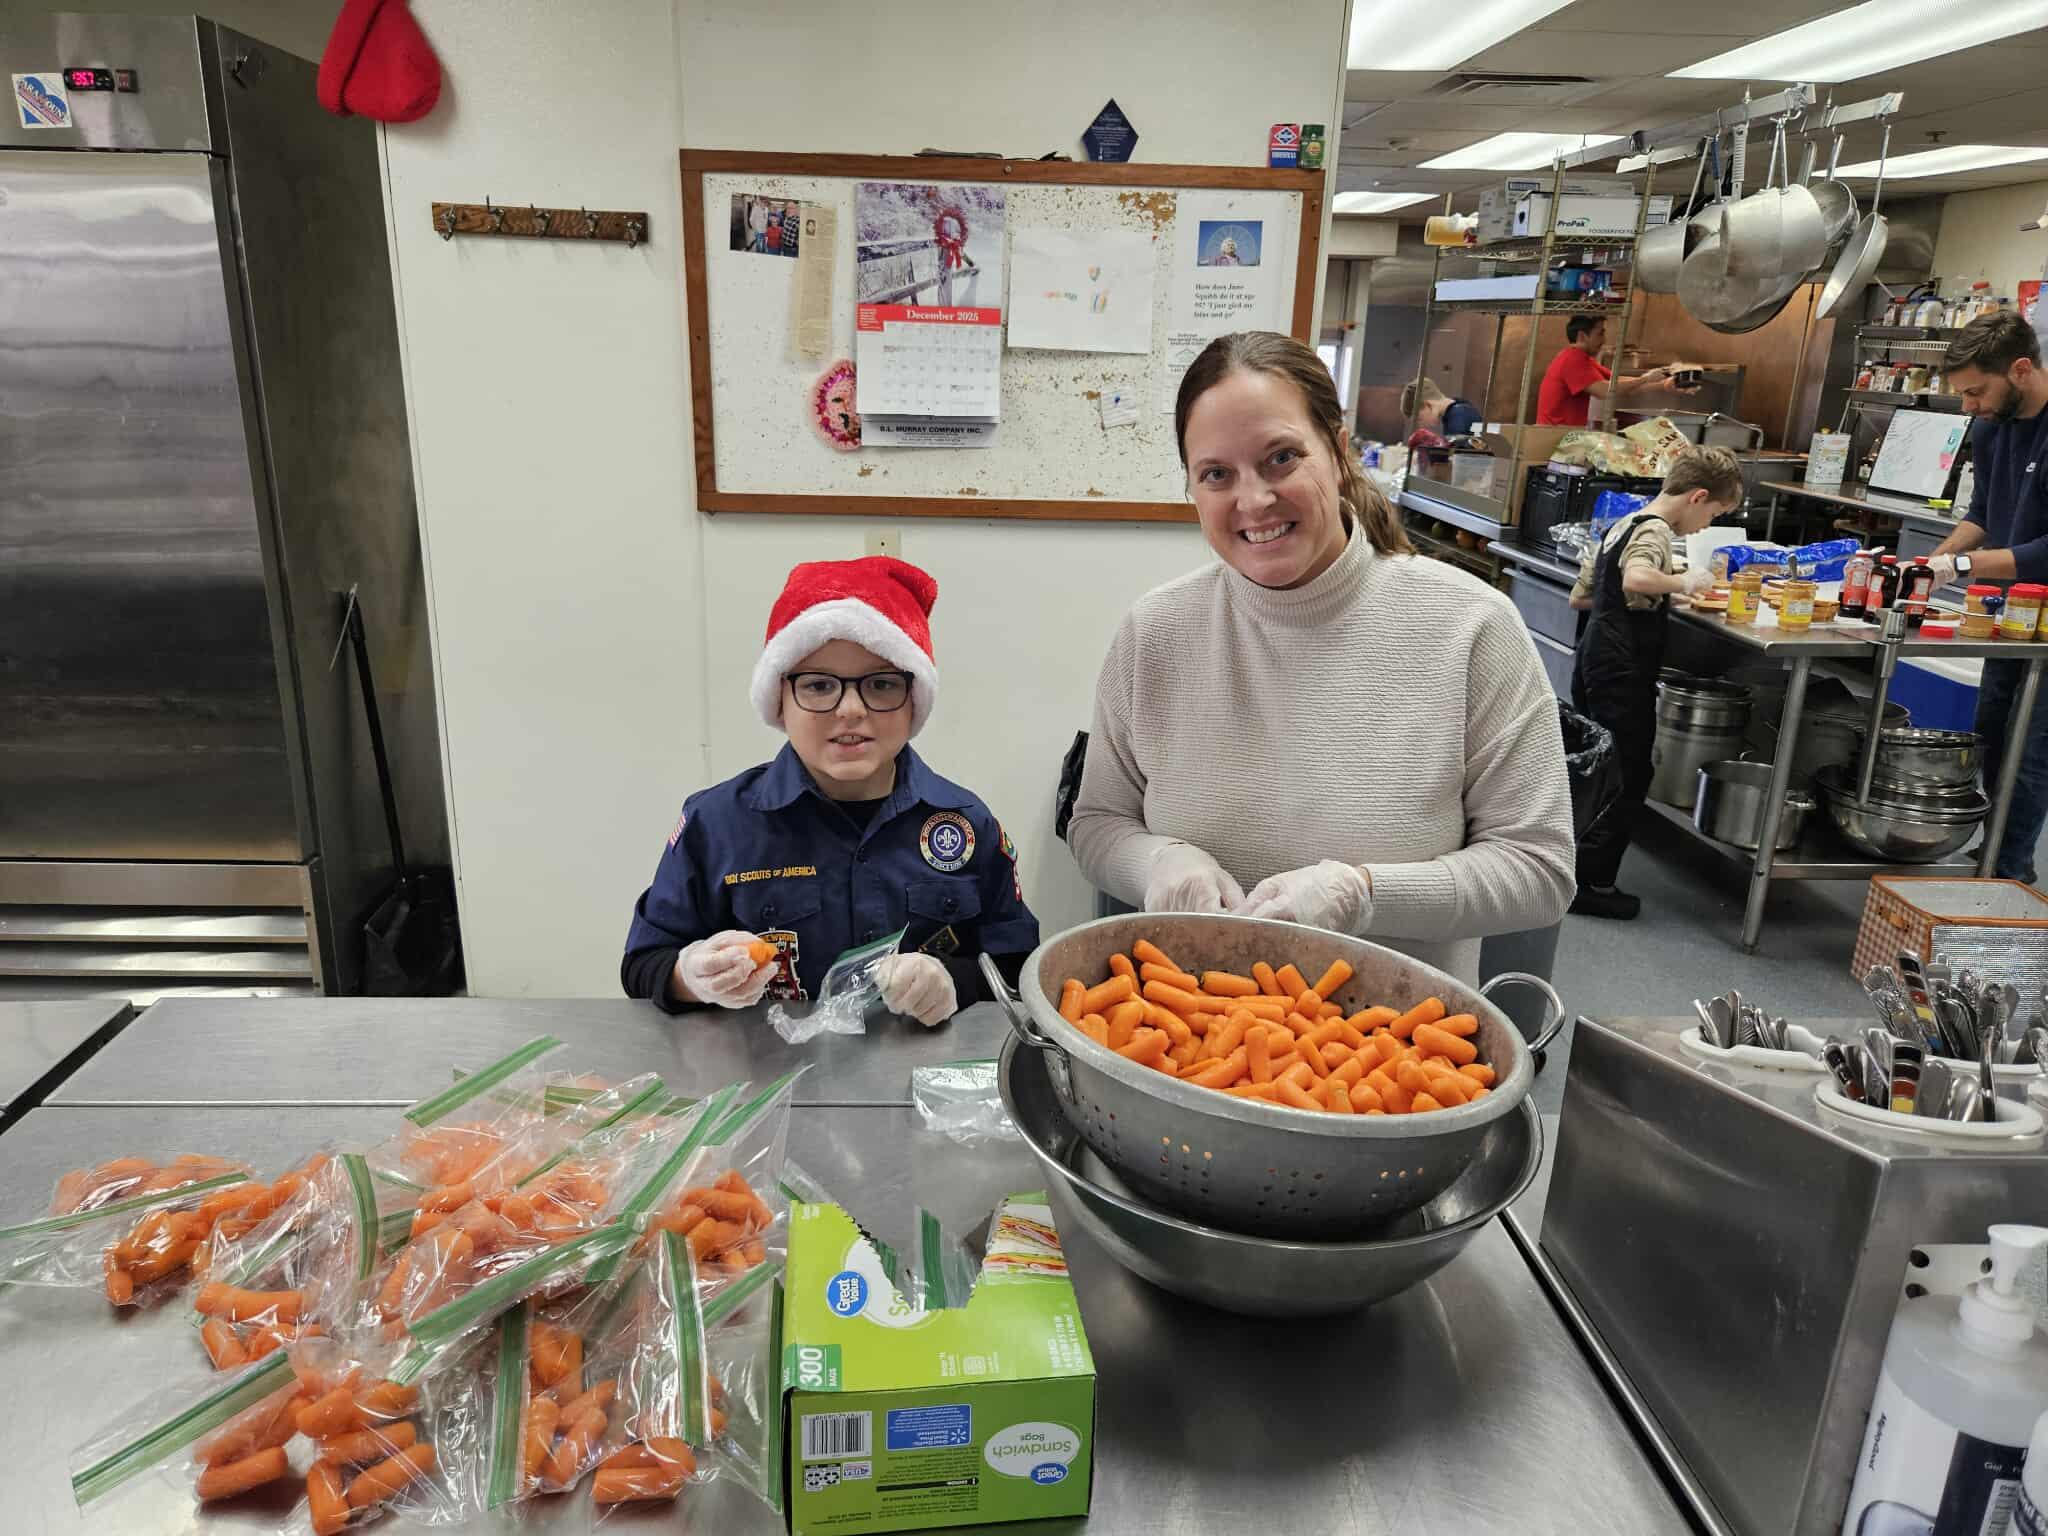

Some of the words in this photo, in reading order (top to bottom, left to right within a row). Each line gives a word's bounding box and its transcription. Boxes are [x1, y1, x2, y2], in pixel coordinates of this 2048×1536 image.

[1556, 219, 1585, 228] ProPak
[906, 309, 955, 320] December
[956, 311, 979, 321] 2025
[896, 425, 927, 433] MURRAY
[928, 426, 966, 434] COMPANY
[740, 870, 771, 882] SCOUTS
[772, 869, 782, 877] OF
[783, 865, 816, 878] AMERICA
[836, 1278, 852, 1312] Great
[849, 1277, 860, 1304] Value
[800, 1347, 823, 1387] 300
[829, 1367, 838, 1387] BAGS
[1020, 1432, 1046, 1442] Bags
[992, 1440, 1073, 1458] Sandwich
[1037, 1471, 1064, 1480] Great
